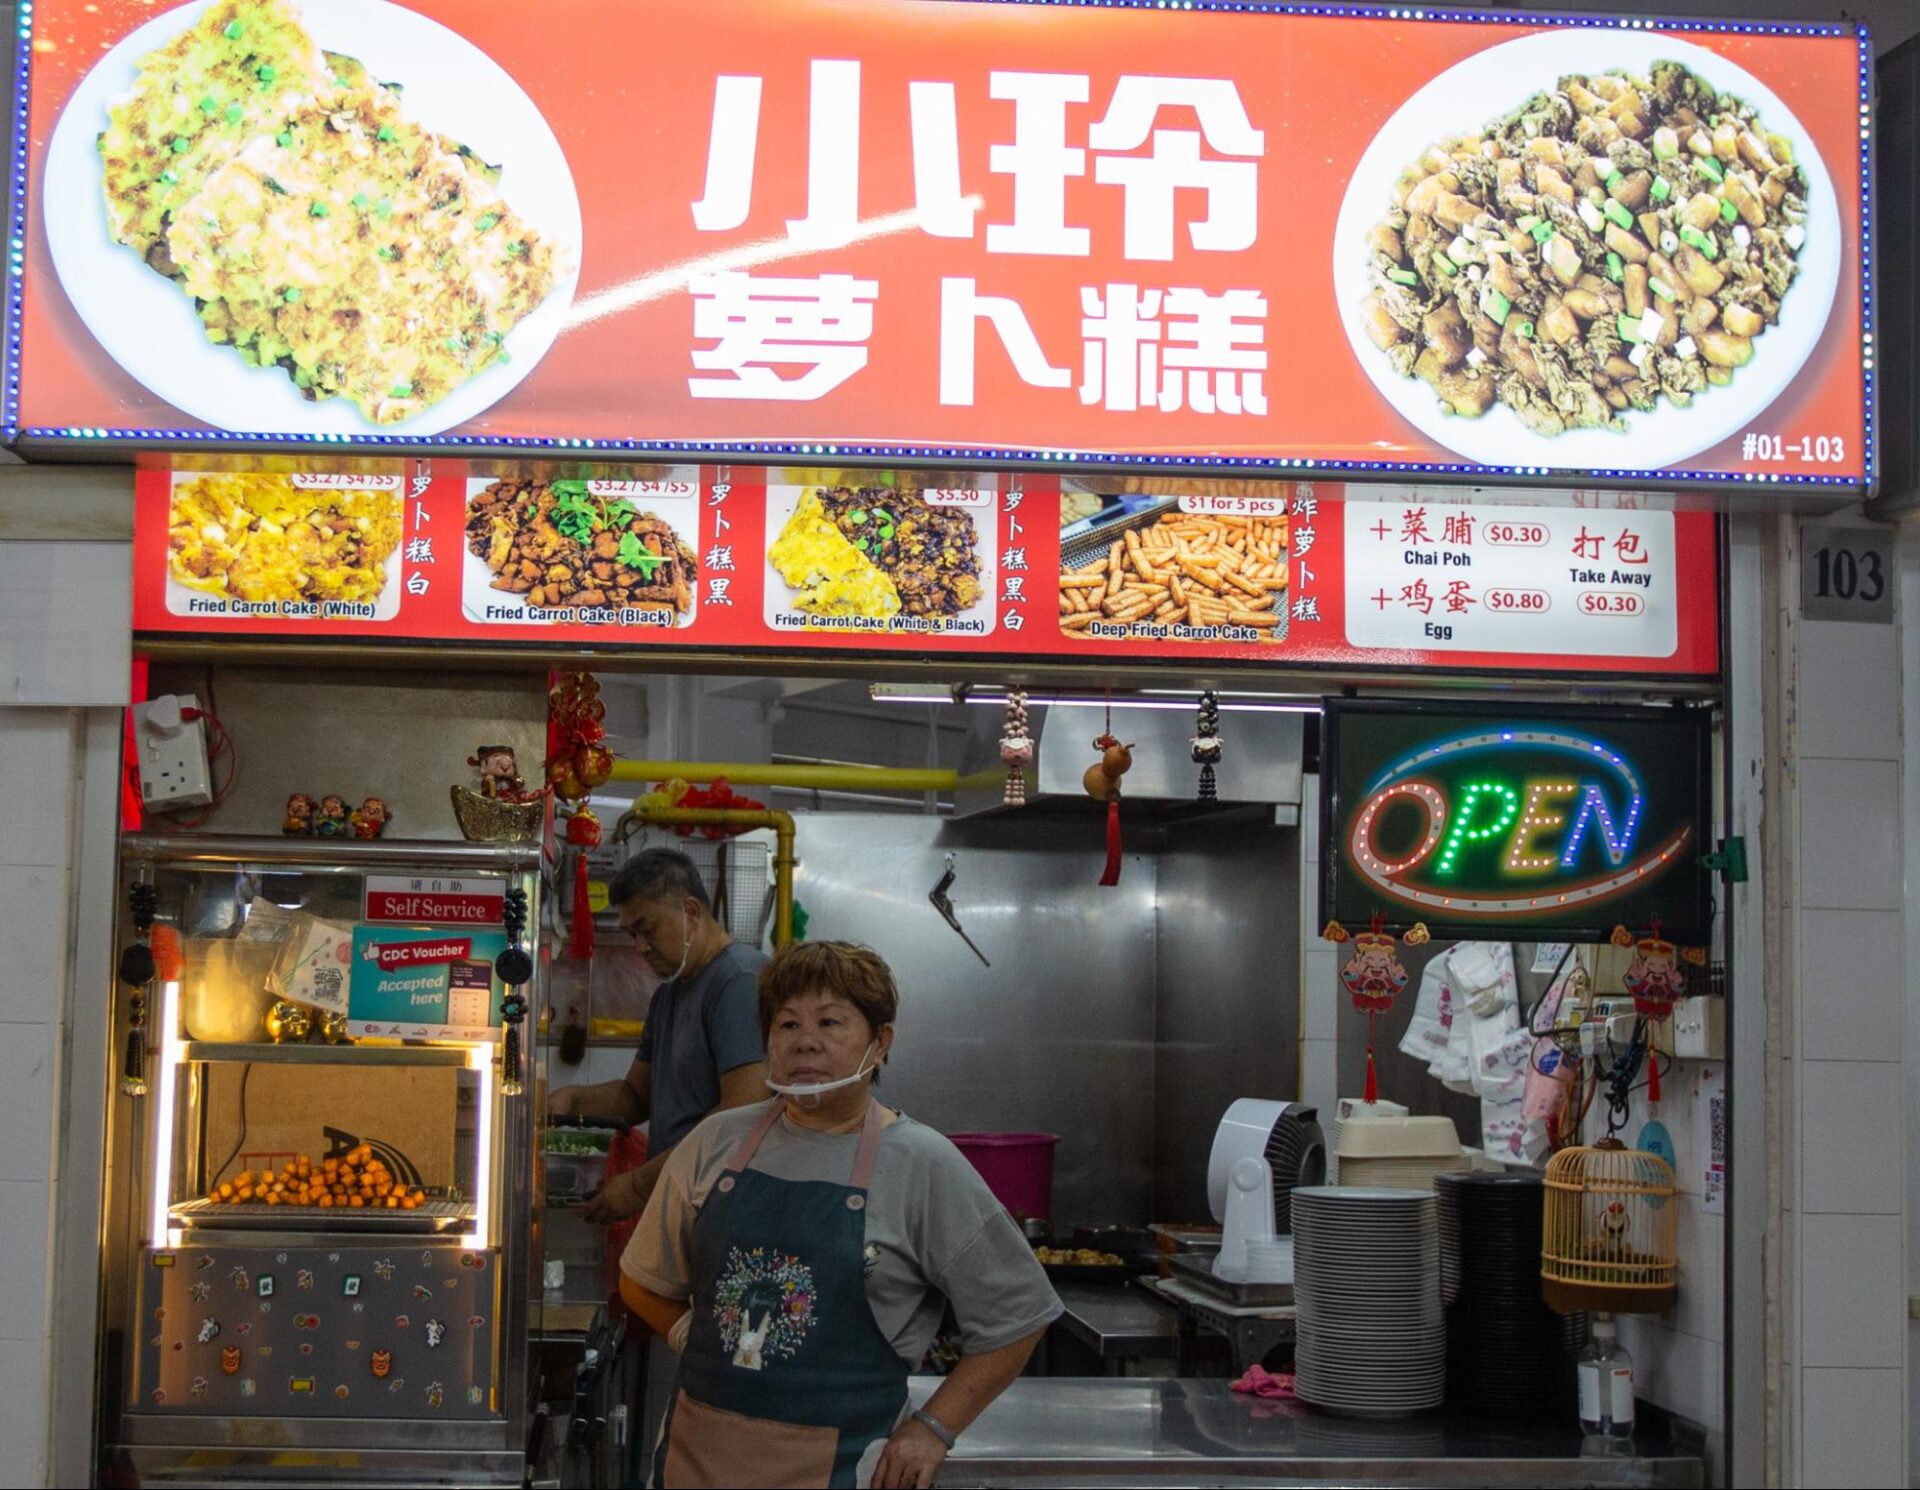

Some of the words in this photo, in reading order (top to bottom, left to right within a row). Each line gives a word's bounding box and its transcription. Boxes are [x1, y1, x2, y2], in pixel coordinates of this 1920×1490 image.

[690, 59, 1265, 261] 小玲
[688, 271, 1268, 416] 萝卜糕
[1742, 433, 1845, 462] #01-103
[936, 490, 979, 501] $5.50
[1188, 497, 1204, 509] $1
[1211, 498, 1232, 510] for
[1237, 498, 1246, 510] 5
[1250, 501, 1275, 513] pcs
[1490, 525, 1542, 543] $0.30
[1571, 525, 1649, 565] 打包
[1404, 551, 1438, 566] Chai
[1443, 552, 1471, 567] Poh
[1570, 568, 1605, 584] Take
[1611, 570, 1652, 586] Away
[1813, 547, 1885, 603] 103
[189, 598, 226, 613] Fried
[231, 599, 277, 614] Carrot
[282, 601, 318, 615] Cake
[323, 602, 376, 618] (White)
[1491, 591, 1544, 610] $0.80
[1585, 596, 1637, 613] $0.30
[486, 605, 523, 620] Fried
[528, 606, 574, 621] Carrot
[578, 608, 615, 622] Cake
[620, 608, 673, 625] (Black)
[775, 613, 806, 626] Fried
[811, 615, 850, 628] Carrot
[853, 617, 884, 629] Cake
[888, 617, 928, 631] (White
[932, 619, 942, 630] &
[945, 619, 985, 633] Black)
[1091, 621, 1127, 638] Deep
[1132, 623, 1168, 638] Fried
[1173, 624, 1218, 639] Carrot
[1222, 625, 1258, 640] Cake
[1424, 623, 1453, 640] Egg
[1352, 782, 1643, 878] OPEN
[384, 897, 419, 916] Self
[422, 899, 486, 918] Service
[382, 950, 409, 962] CDC
[412, 945, 465, 960] Voucher
[377, 975, 444, 994] Accepted
[410, 993, 443, 1005] here
